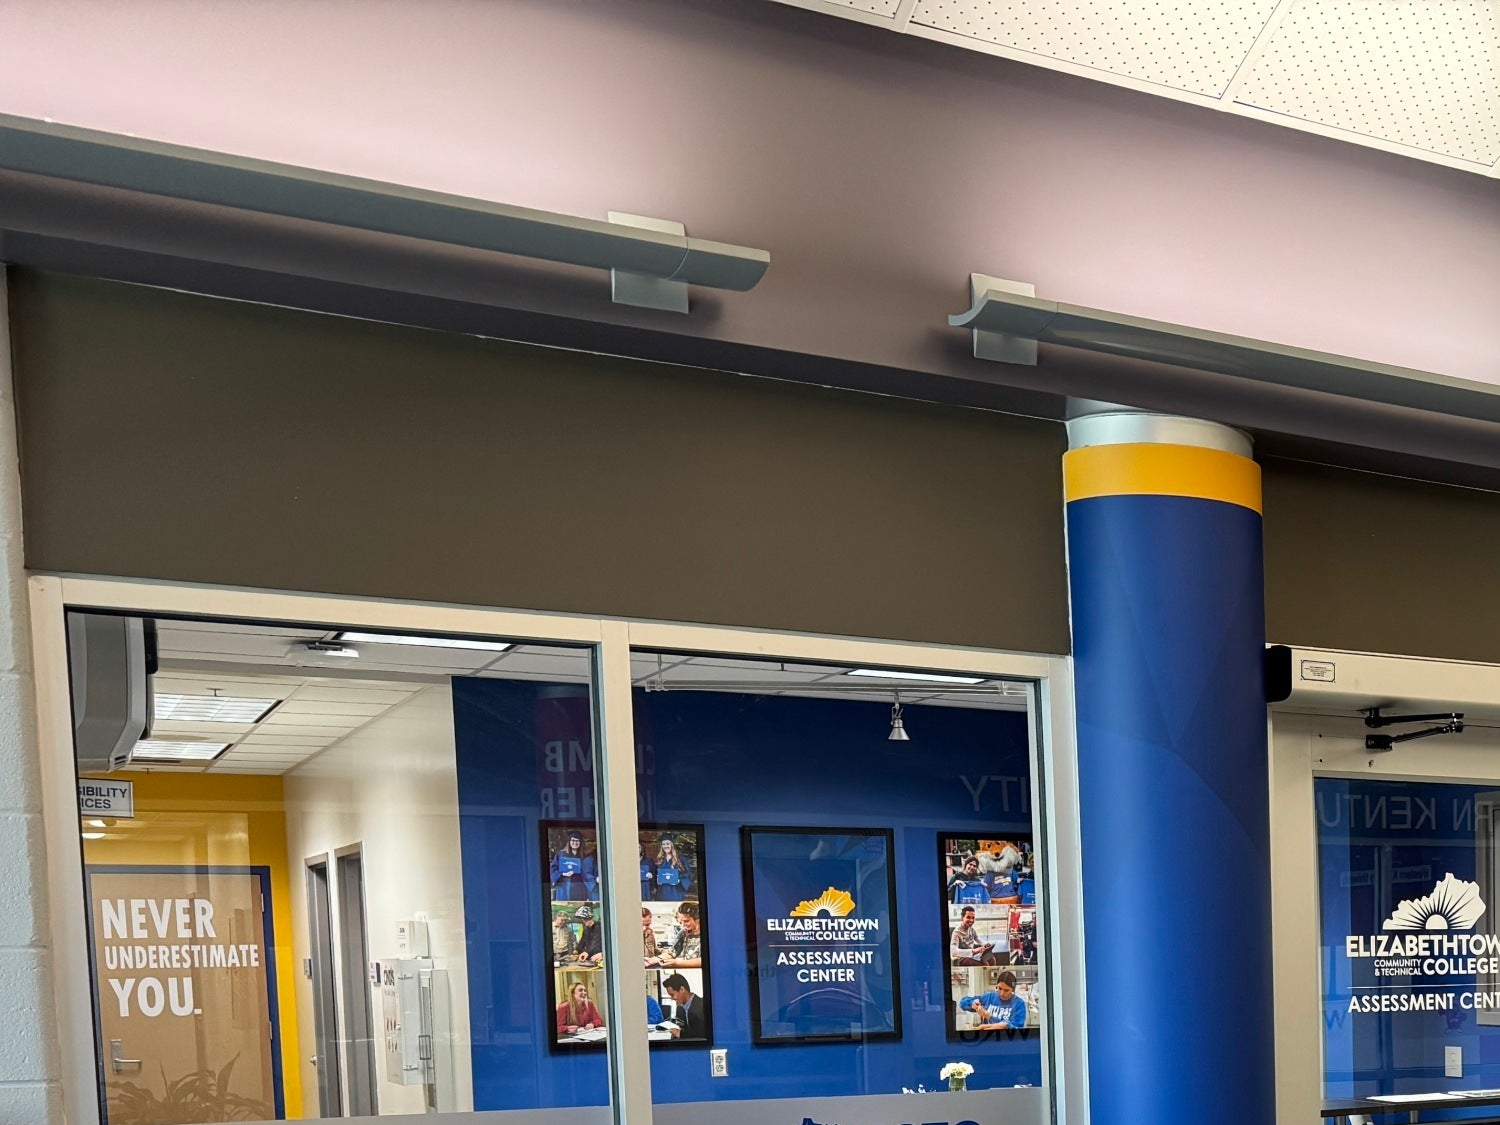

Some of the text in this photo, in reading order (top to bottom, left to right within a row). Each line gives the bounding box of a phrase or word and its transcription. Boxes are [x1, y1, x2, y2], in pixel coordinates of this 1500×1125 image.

[81, 798, 112, 809] ICES
[101, 899, 217, 938] NEVER
[767, 918, 879, 931] ELIZABETHTOWN
[816, 931, 865, 940] COLLEGE
[104, 944, 259, 970] UNDERESTIMATE
[777, 951, 873, 965] ASSESSMENT
[1374, 959, 1421, 968] COMMUNITY
[1375, 967, 1422, 976] & TECHNICAL
[1423, 958, 1499, 975] COLLEGE
[797, 969, 855, 982] CENTER
[108, 977, 203, 1017] YOU.
[1348, 993, 1456, 1013] ASSESSMENT
